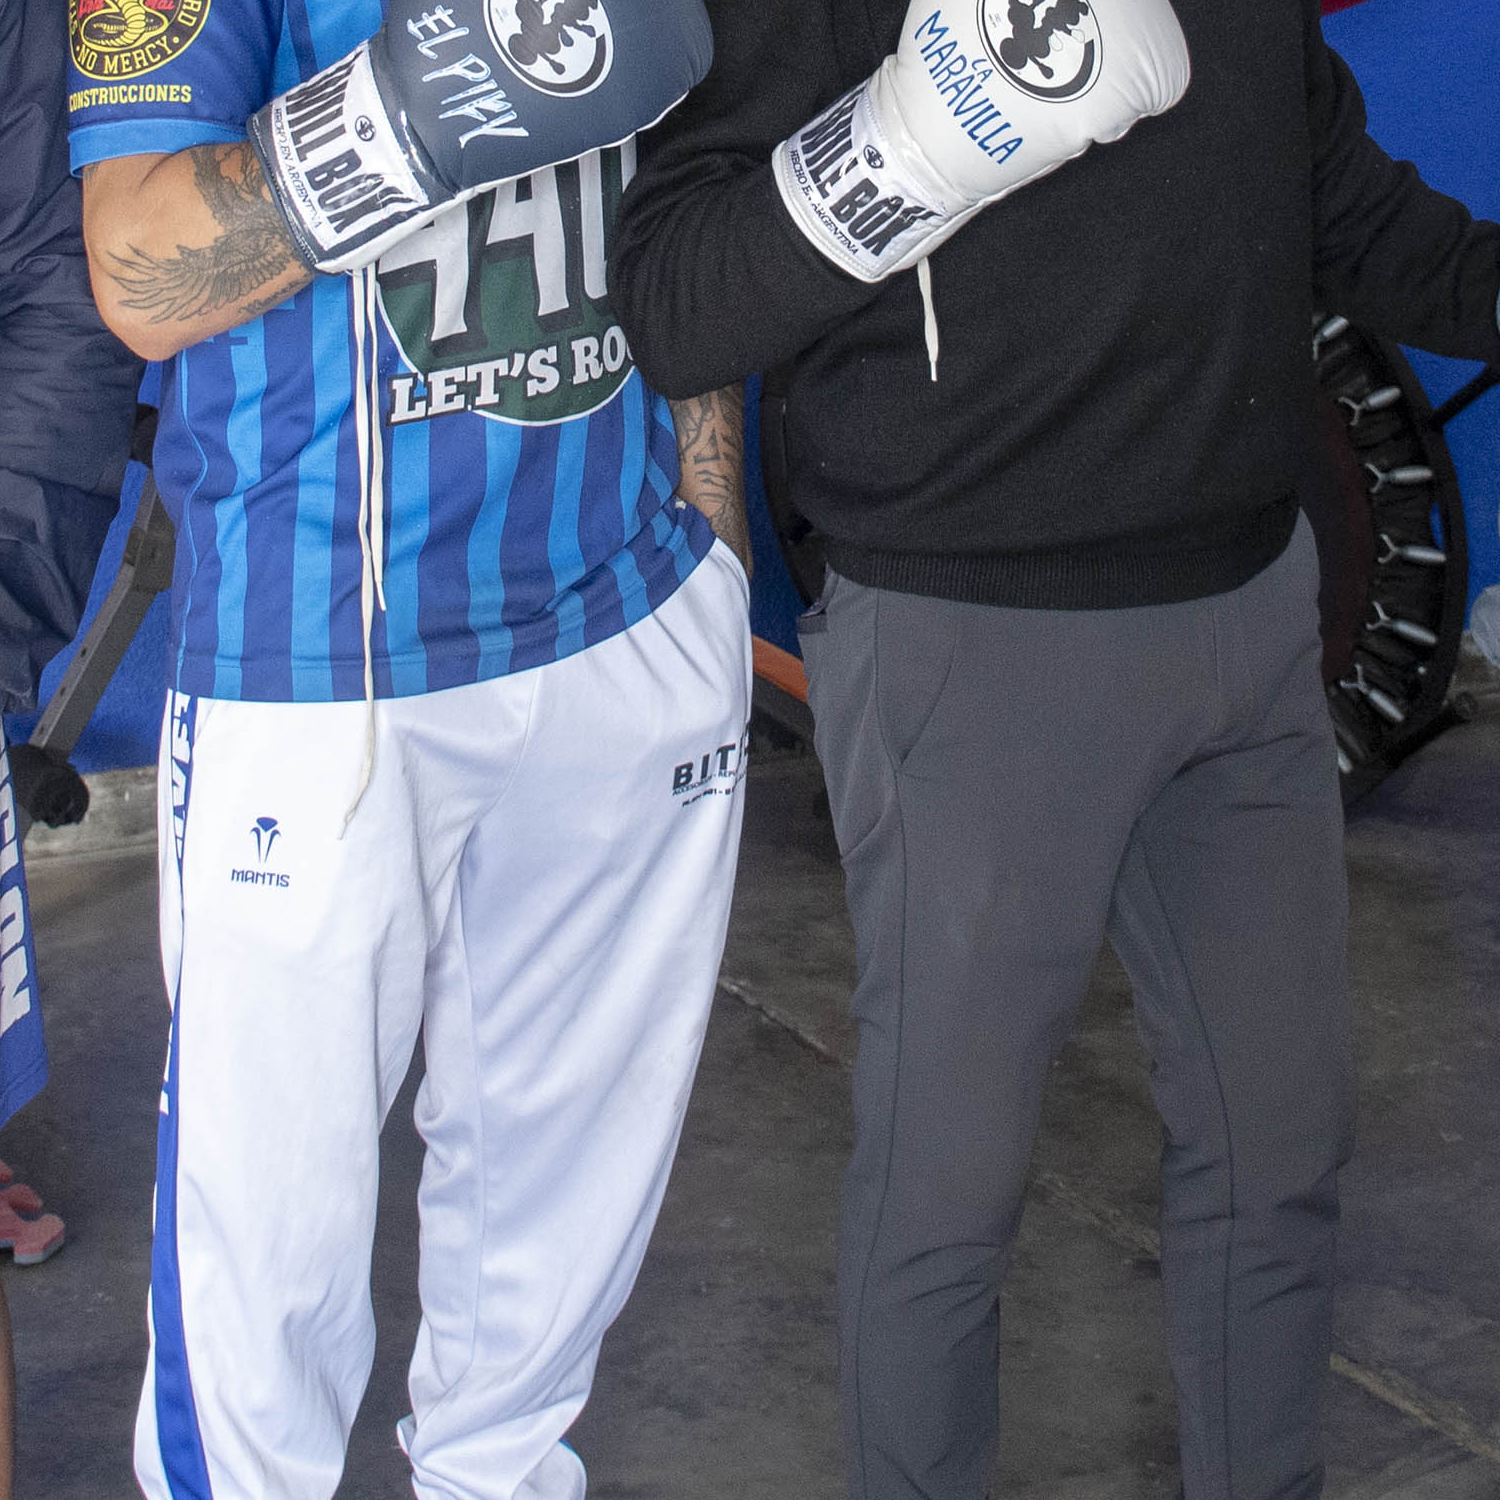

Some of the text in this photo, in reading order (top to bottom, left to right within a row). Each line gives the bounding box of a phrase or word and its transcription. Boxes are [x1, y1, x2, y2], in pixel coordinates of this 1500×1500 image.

[77, 35, 173, 75] NO MERCY
[406, 4, 530, 149] EL PIKY
[914, 10, 1024, 165] MARAVILLA
[971, 58, 994, 83] LA
[68, 83, 192, 113] CONSTRUCCIONES
[303, 147, 421, 235] BOX
[828, 177, 945, 257] BOX
[811, 202, 860, 256] ARGENTINA
[390, 345, 560, 423] LET'S
[230, 868, 291, 888] MANTIS
